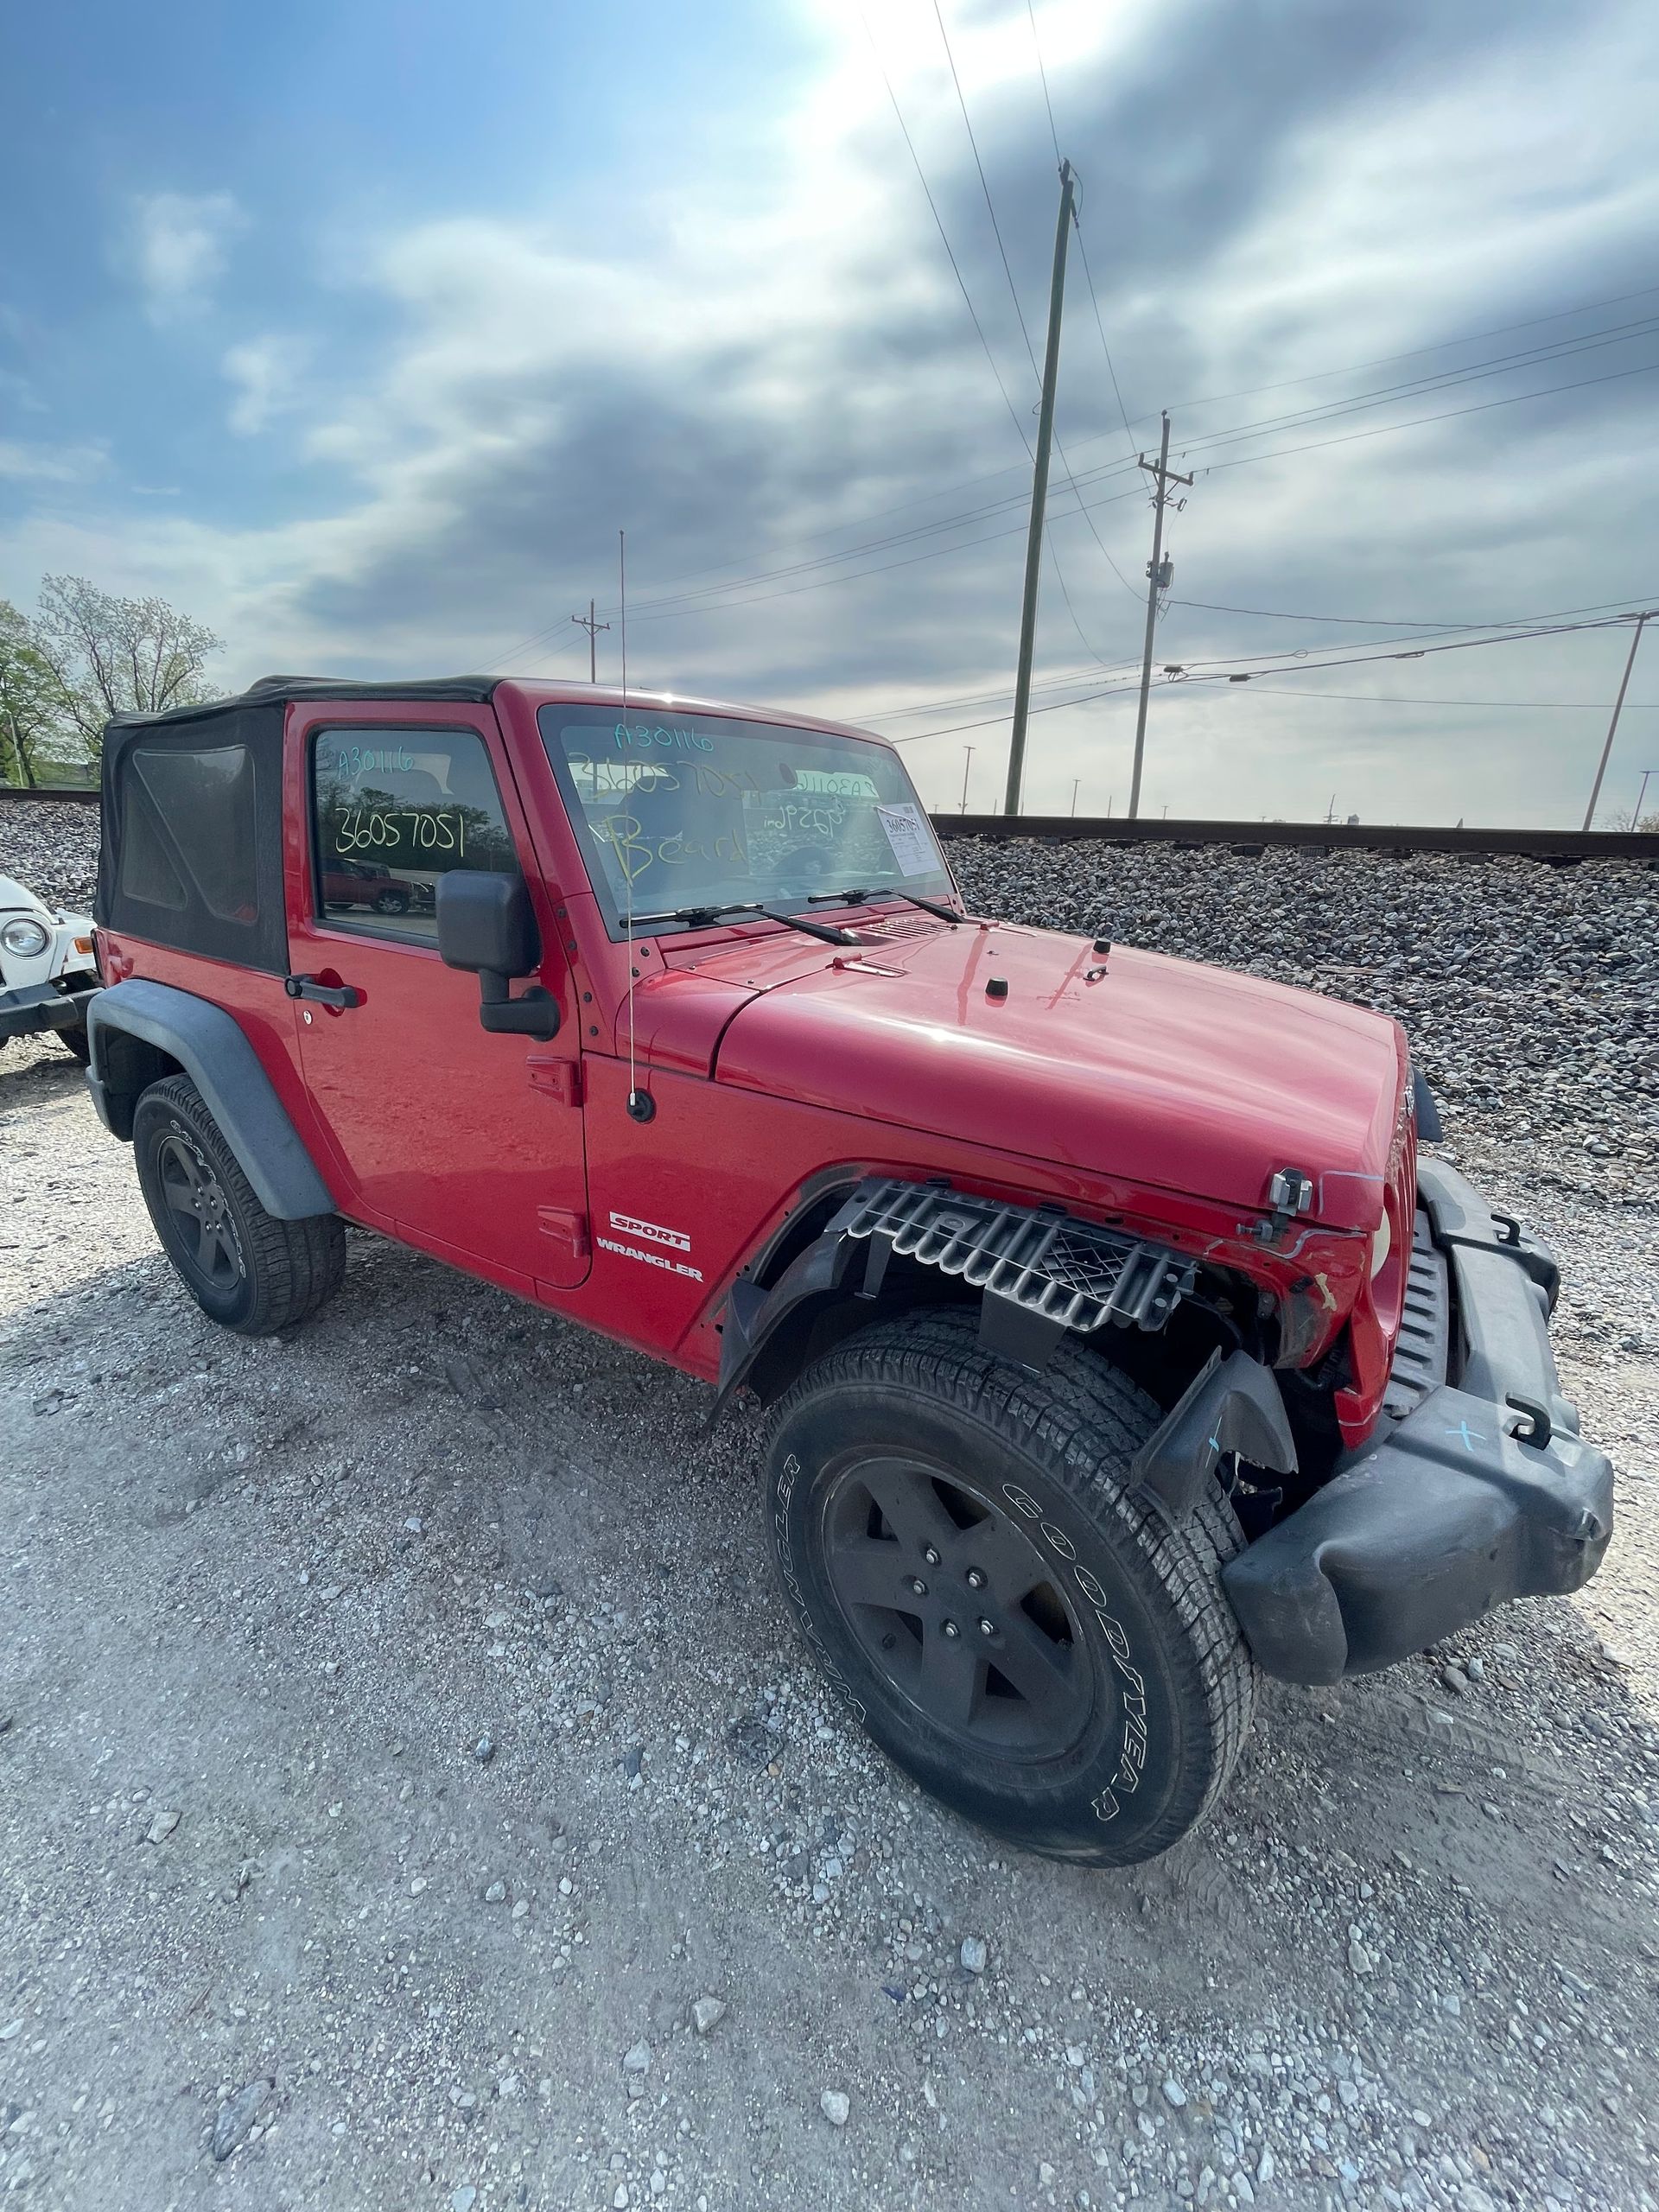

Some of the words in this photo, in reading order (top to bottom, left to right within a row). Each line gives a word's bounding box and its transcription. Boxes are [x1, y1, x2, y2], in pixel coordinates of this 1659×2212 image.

[614, 723, 714, 752] A30116
[338, 746, 415, 779] A30116
[335, 807, 464, 858] 36057051
[611, 1215, 690, 1247] SPORT
[596, 1236, 704, 1283] WRANGLER
[1001, 1483, 1147, 1821] GOODYEAR
